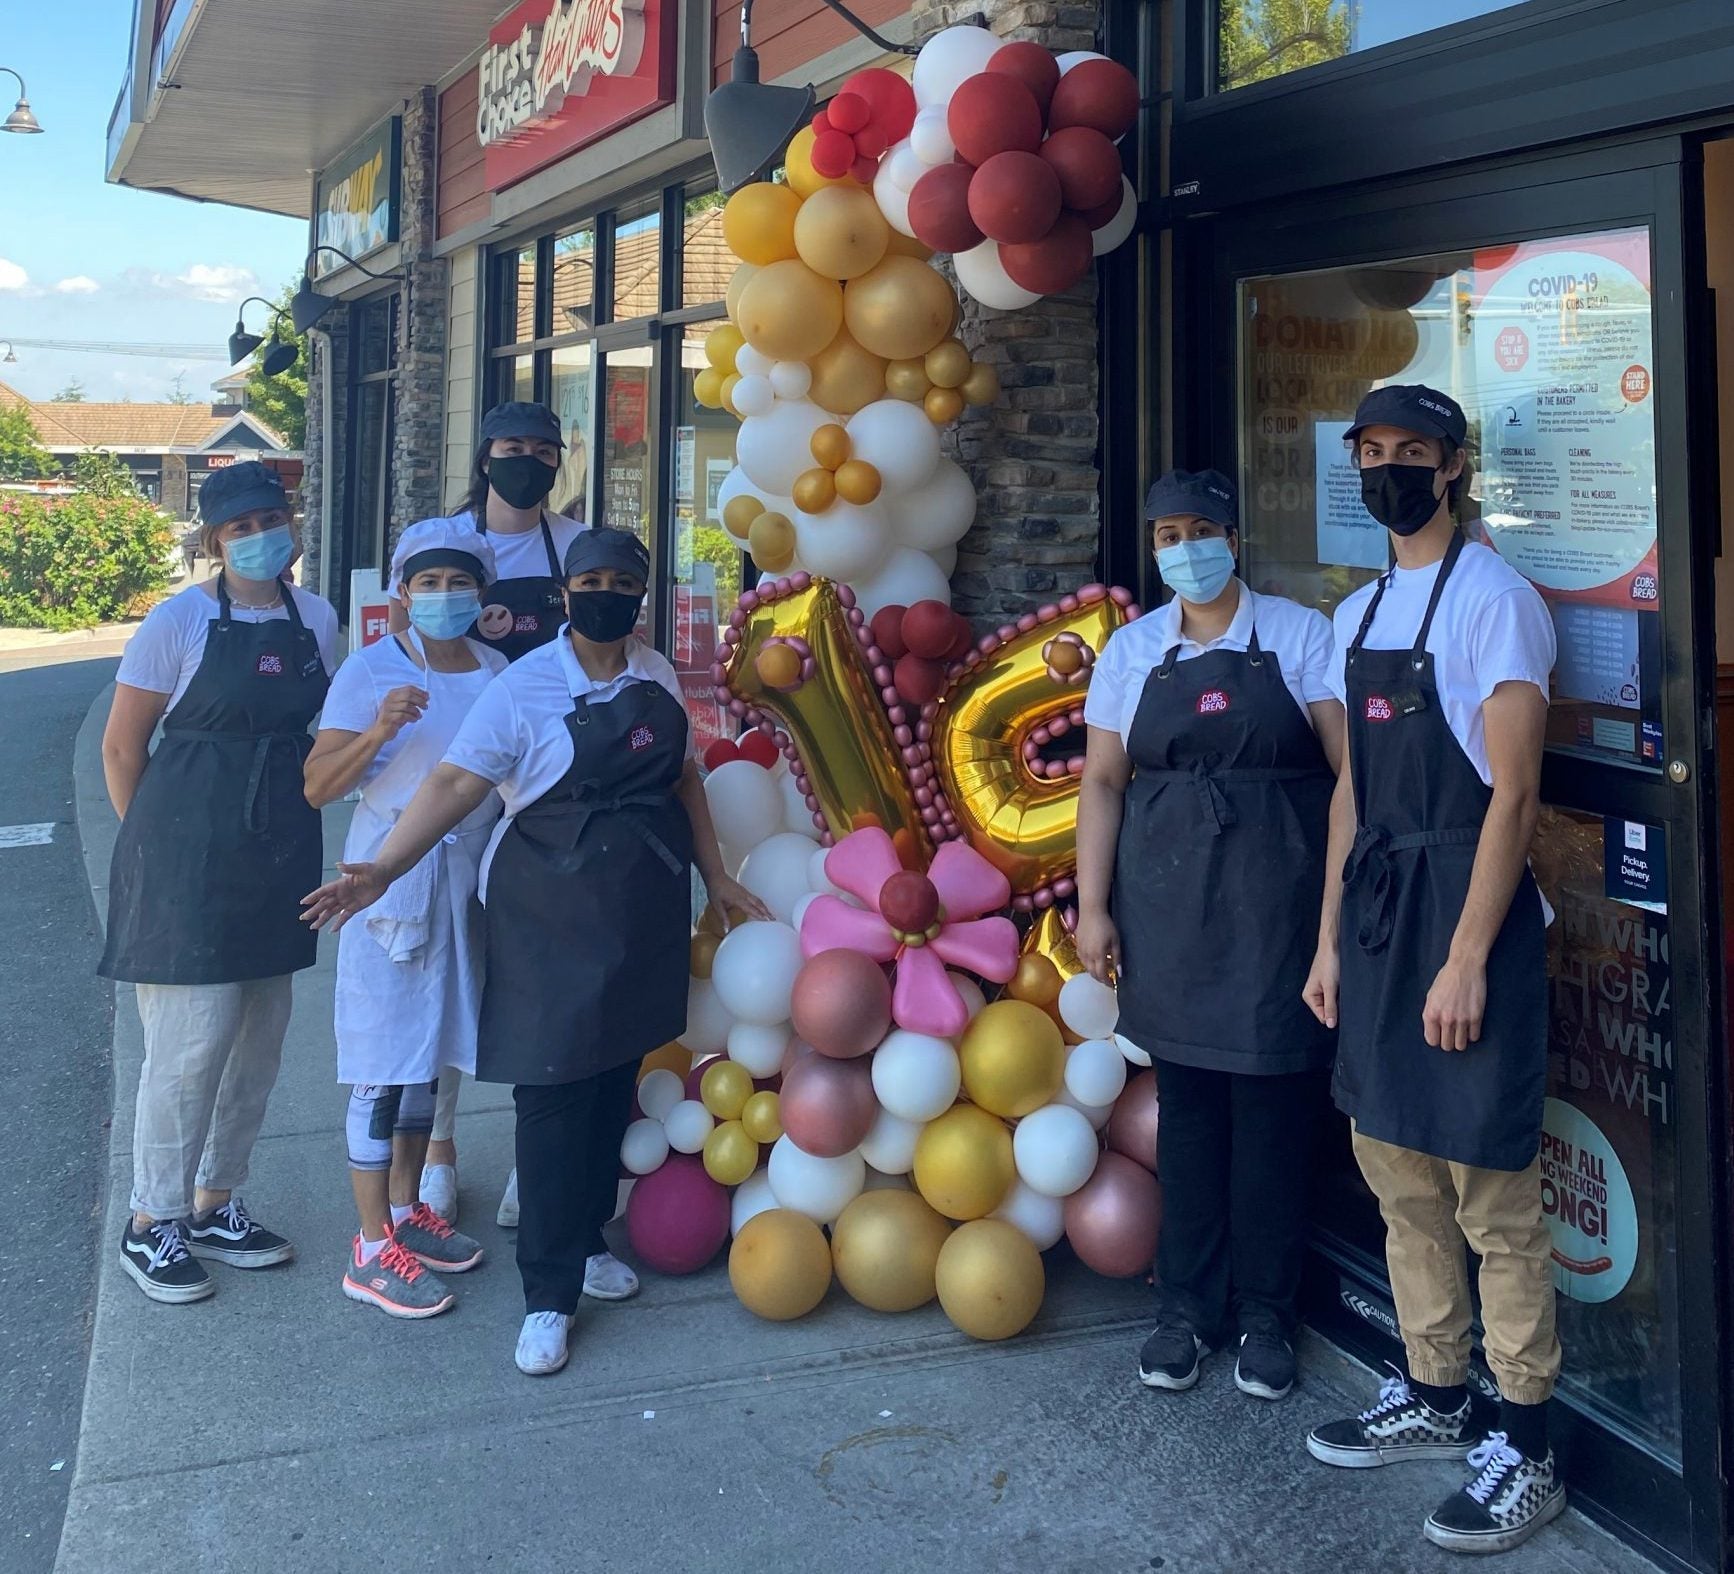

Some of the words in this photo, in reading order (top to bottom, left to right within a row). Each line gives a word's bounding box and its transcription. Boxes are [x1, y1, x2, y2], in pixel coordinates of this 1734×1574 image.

[479, 22, 532, 105] First
[476, 79, 534, 147] Choice
[1174, 184, 1198, 197] STANLEY
[1528, 272, 1598, 297] COVID-19
[1566, 298, 1585, 311] COBS
[1625, 371, 1646, 379] STAND
[1625, 379, 1646, 390] HERE
[1545, 396, 1555, 406] THE
[1556, 396, 1576, 406] BAKERY
[1263, 416, 1273, 434] IS
[1276, 416, 1298, 434] OUR
[1501, 447, 1523, 456] PERSONAL
[1524, 447, 1536, 456] BAGS
[1568, 448, 1591, 457] CLEANING
[611, 468, 626, 481] STORE
[626, 468, 643, 481] HOURS
[1570, 489, 1580, 498] FOR
[1591, 490, 1616, 500] MEASURES
[1534, 510, 1561, 520] PREFERRED
[1634, 576, 1655, 588] COBS
[1632, 588, 1657, 600] BREAD
[517, 615, 536, 624] COBS
[515, 623, 538, 632] BREAD
[260, 655, 280, 665] COBS
[258, 664, 281, 673] BREAD
[1201, 692, 1223, 704] COBS
[1368, 697, 1388, 708] COBS
[1200, 701, 1227, 713] BREAD
[1367, 707, 1391, 719] BREAD
[631, 727, 649, 740] COBS
[631, 733, 654, 750] BREAD
[1623, 854, 1648, 870] Pickup.
[1621, 865, 1650, 883] Delivery.
[1578, 1148, 1607, 1186] ALL
[1557, 1166, 1607, 1205] WEEKEND
